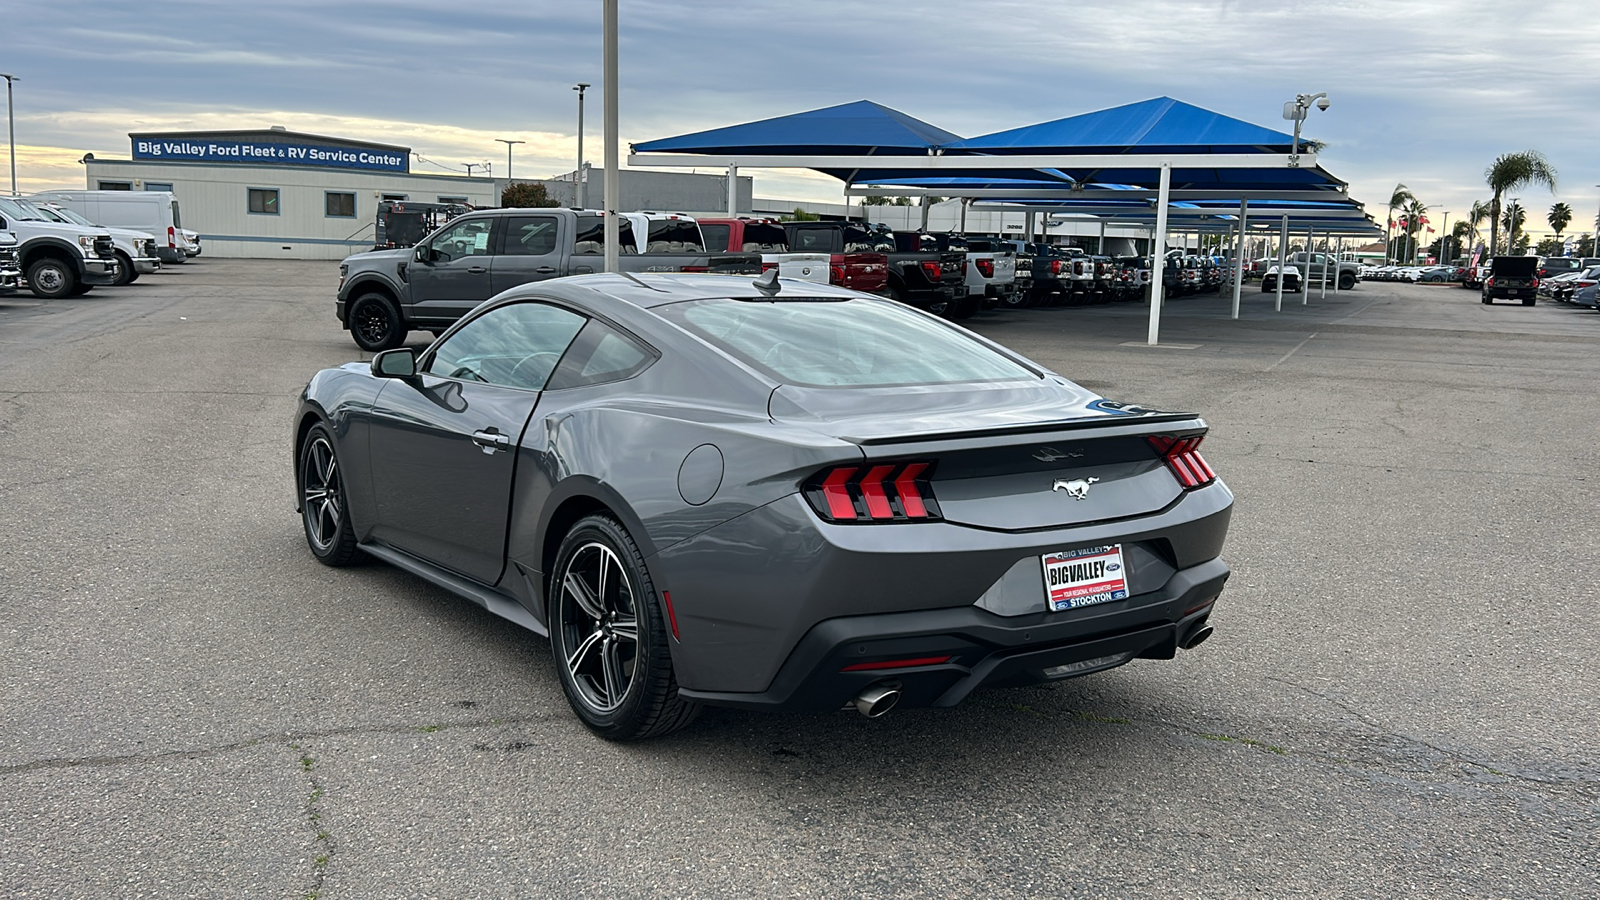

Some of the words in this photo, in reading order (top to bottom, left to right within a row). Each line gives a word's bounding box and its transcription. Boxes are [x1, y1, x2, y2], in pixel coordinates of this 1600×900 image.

[138, 142, 162, 156] Big
[164, 142, 206, 157] Valley
[209, 144, 239, 156] Ford
[242, 145, 276, 158] Fleet
[278, 149, 285, 158] &
[288, 147, 307, 159] RV
[309, 148, 357, 163] Service
[359, 152, 402, 166] Center
[1078, 547, 1103, 555] VALLEY
[1050, 560, 1105, 585] BIGVALLEY
[1070, 593, 1112, 607] STOCKTON
